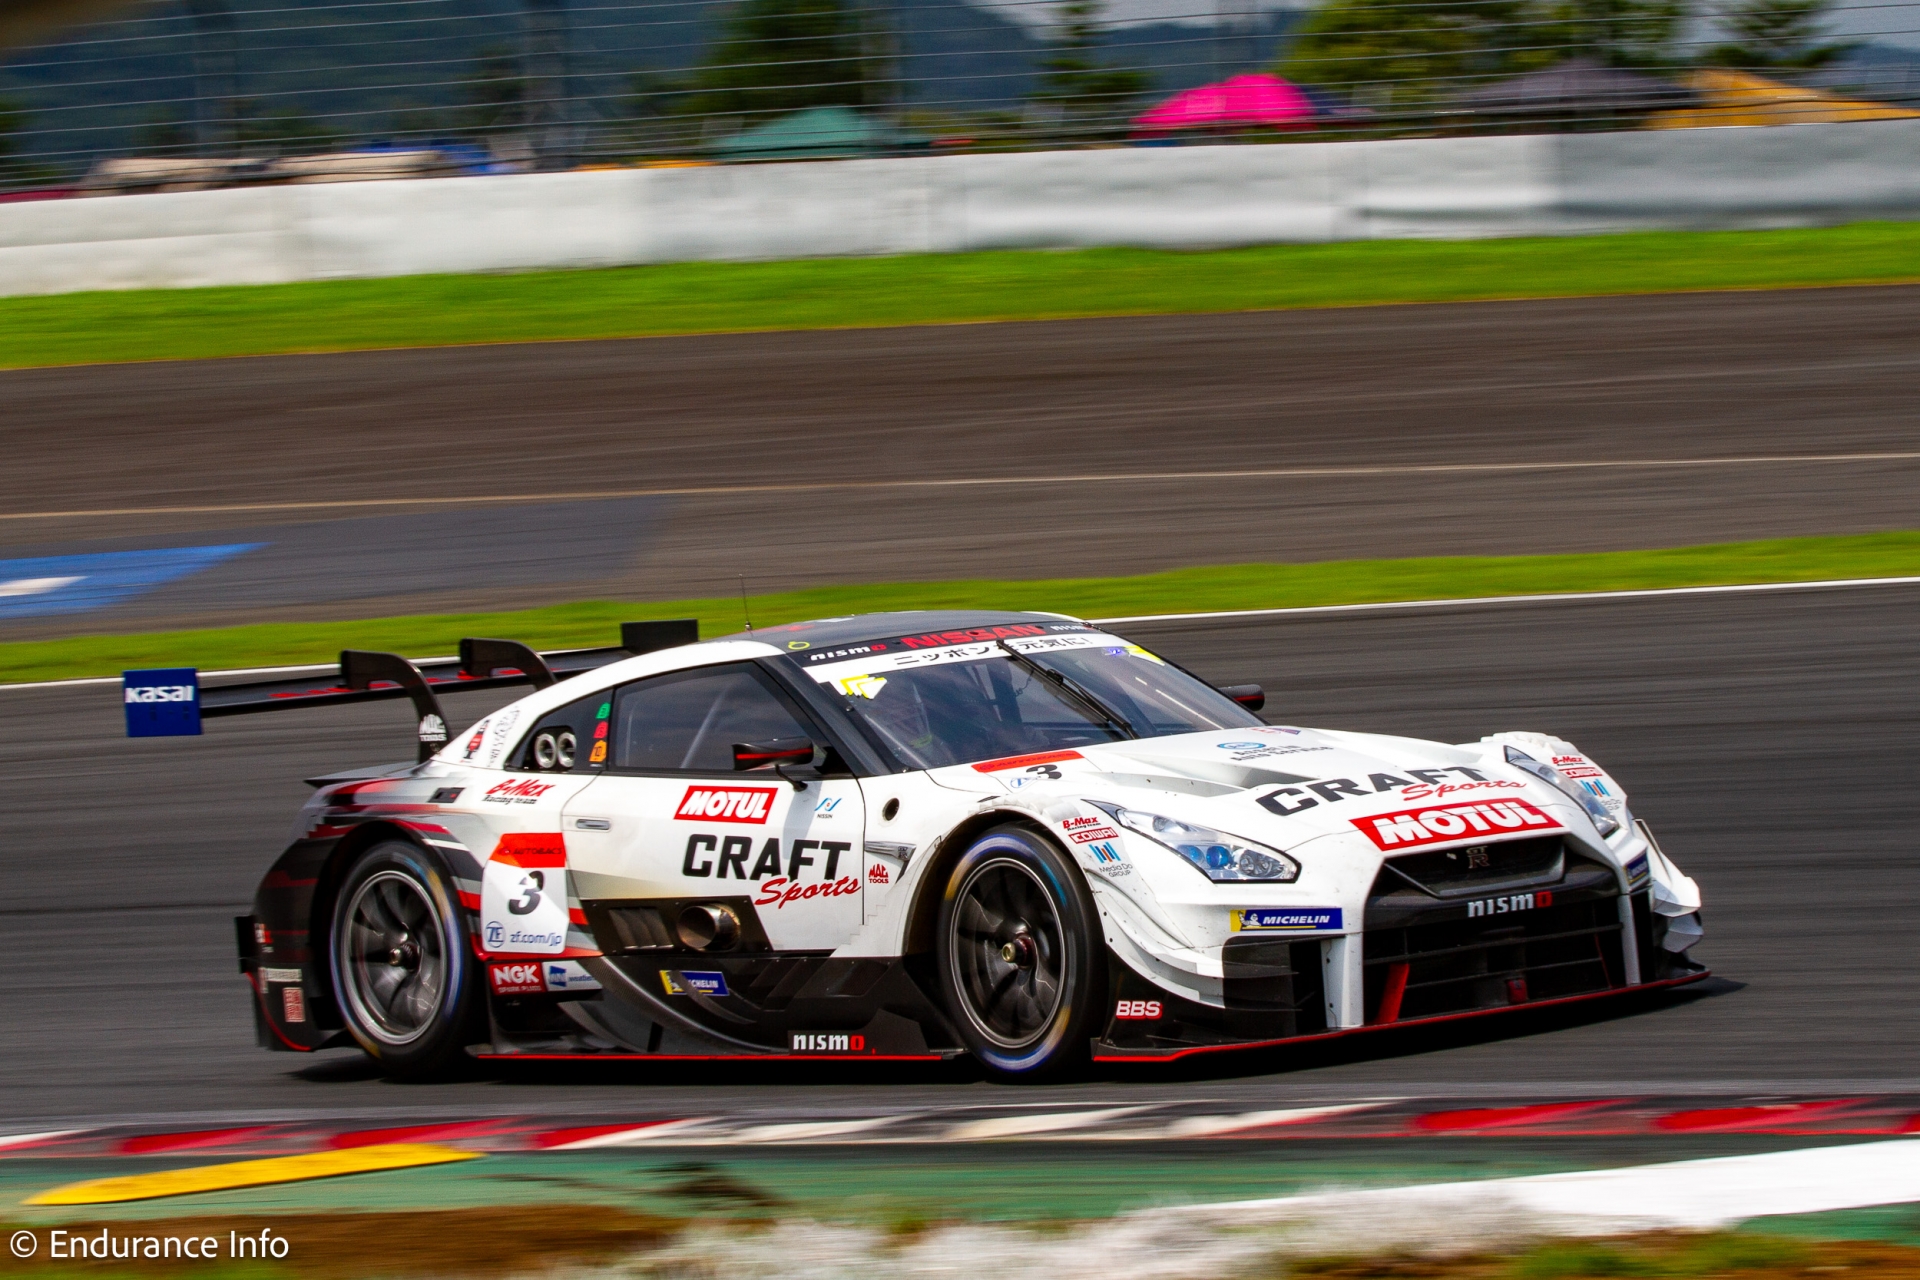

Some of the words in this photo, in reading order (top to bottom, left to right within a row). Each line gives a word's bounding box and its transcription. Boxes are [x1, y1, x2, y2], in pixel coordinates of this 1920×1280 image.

[810, 645, 887, 661] nismo
[901, 625, 1047, 649] NISSAN
[1026, 764, 1062, 780] 3
[1255, 766, 1490, 816] CRAFT
[1401, 779, 1527, 801] Sports
[679, 791, 769, 818] MOTUL
[1063, 817, 1098, 829] B-Max
[1372, 801, 1548, 844] MOTUL
[682, 834, 852, 882] CRAFT
[868, 863, 888, 877] MAC
[508, 870, 545, 915] 3
[754, 876, 862, 909] Sports
[1467, 891, 1553, 918] nismo
[1262, 914, 1330, 925] MICHELIN
[510, 931, 562, 947] zf.com/jp
[493, 964, 539, 985] NGK
[689, 979, 719, 988] CHELIN
[1116, 1000, 1162, 1019] BBS
[793, 1034, 865, 1050] nismo
